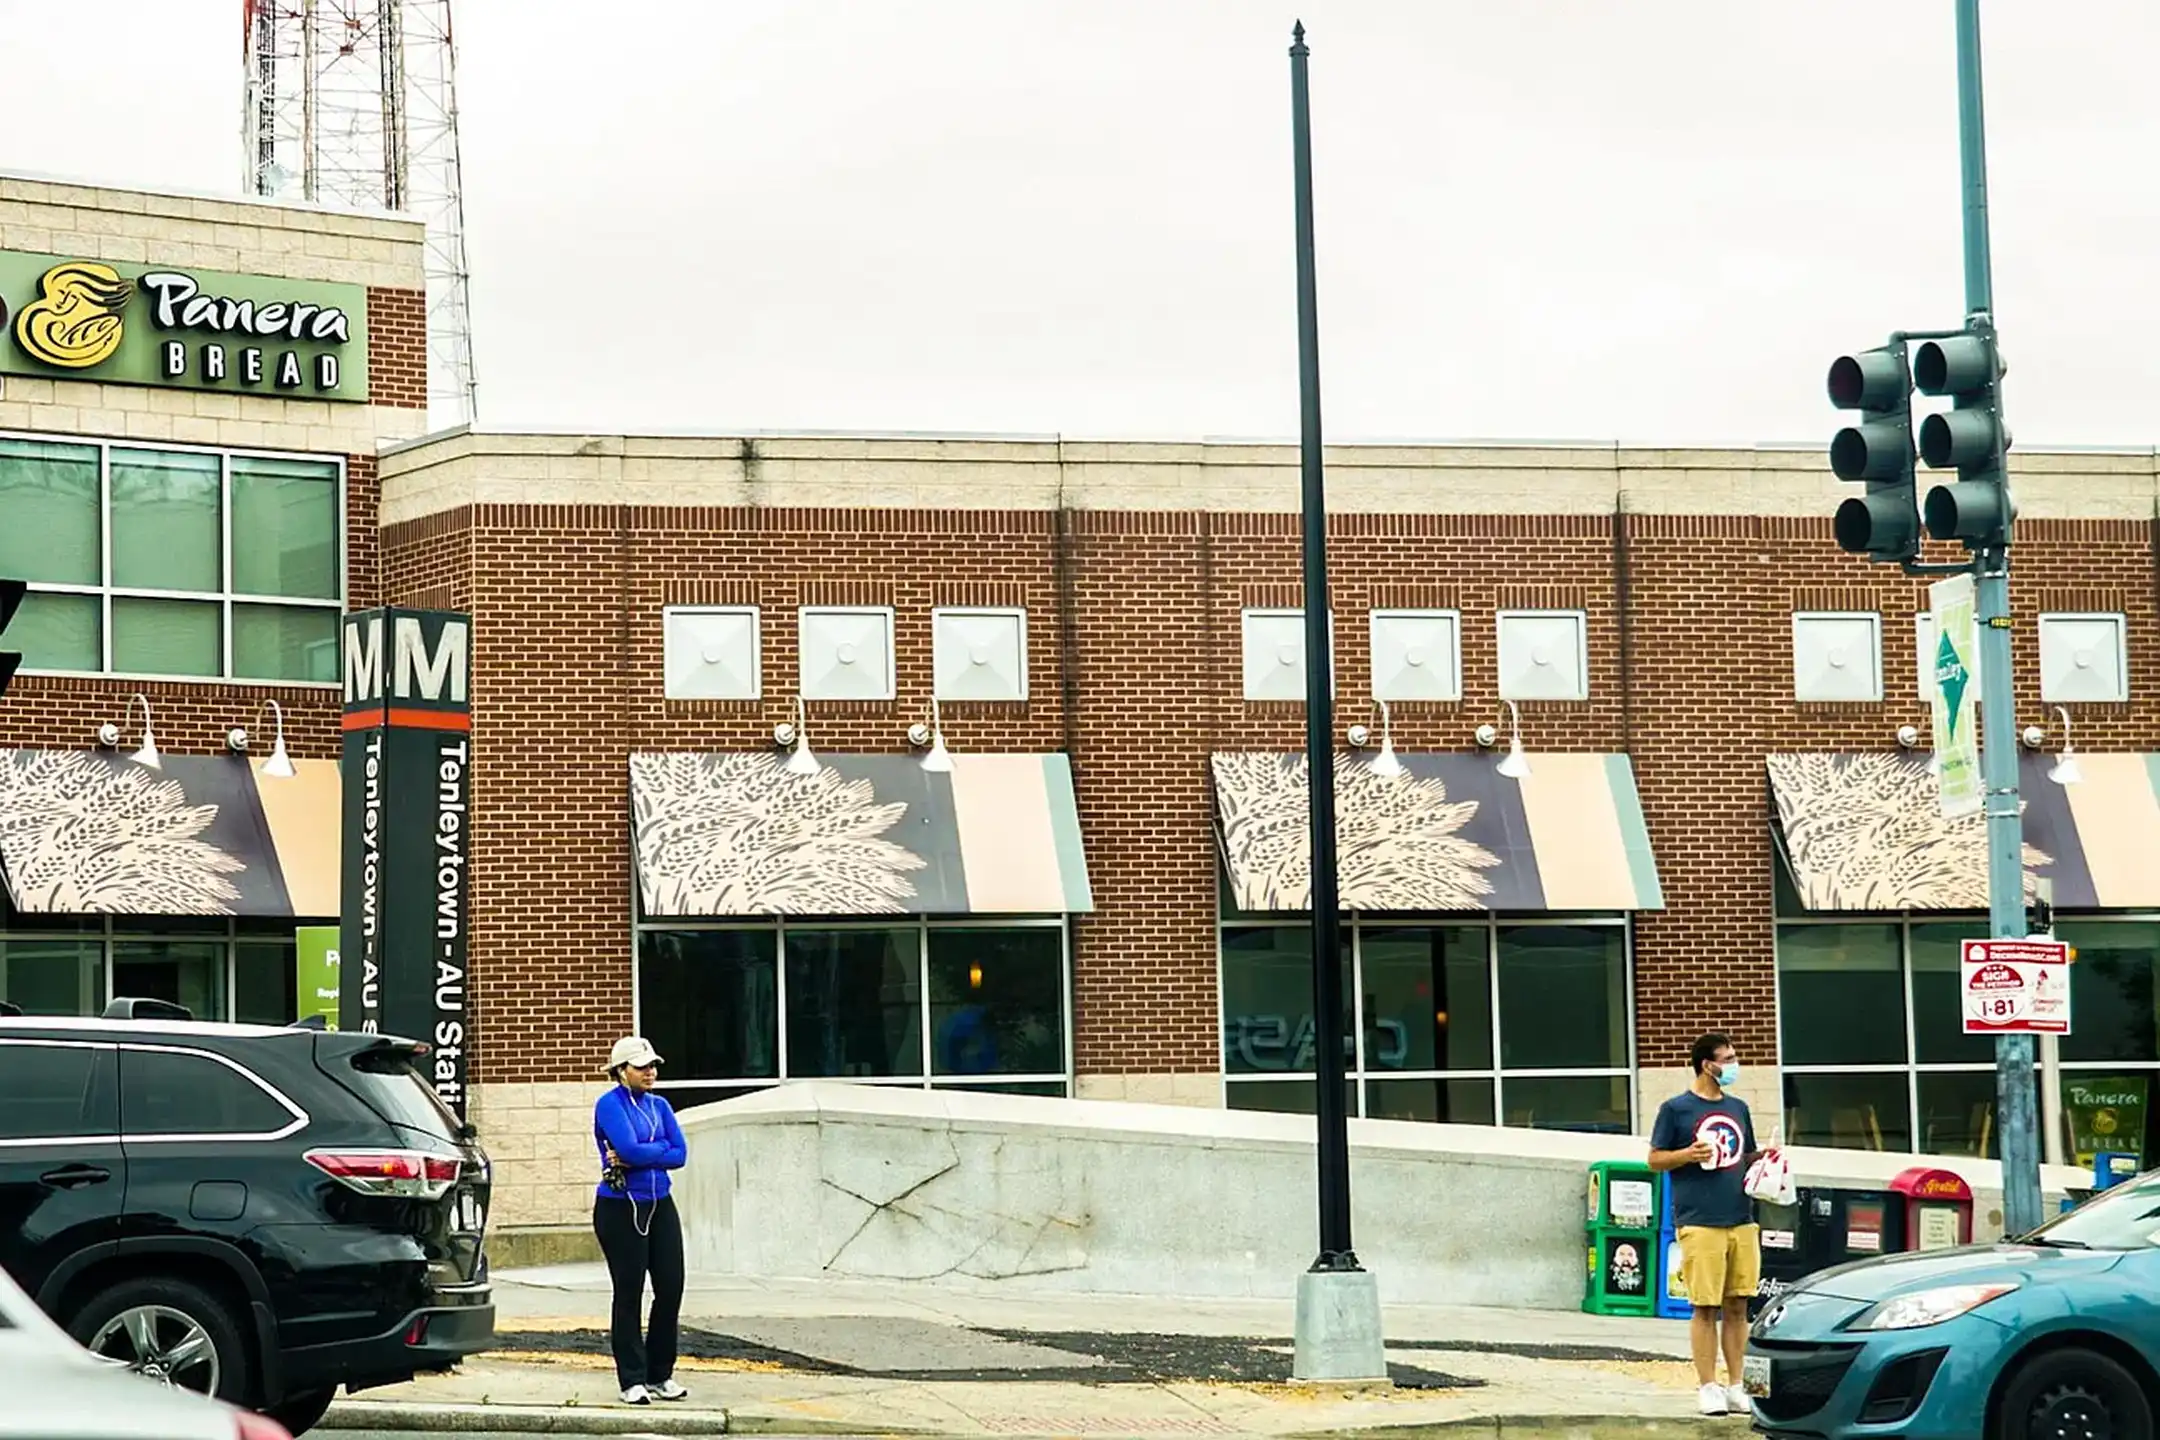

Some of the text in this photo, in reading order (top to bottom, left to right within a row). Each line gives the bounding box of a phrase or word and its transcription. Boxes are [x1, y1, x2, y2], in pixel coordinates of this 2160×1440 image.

[143, 271, 350, 342] Panera
[166, 341, 340, 389] BREAD
[344, 618, 383, 704] M
[394, 617, 467, 702] M
[435, 1020, 464, 1112] Stati
[2070, 1086, 2140, 1105] Panera
